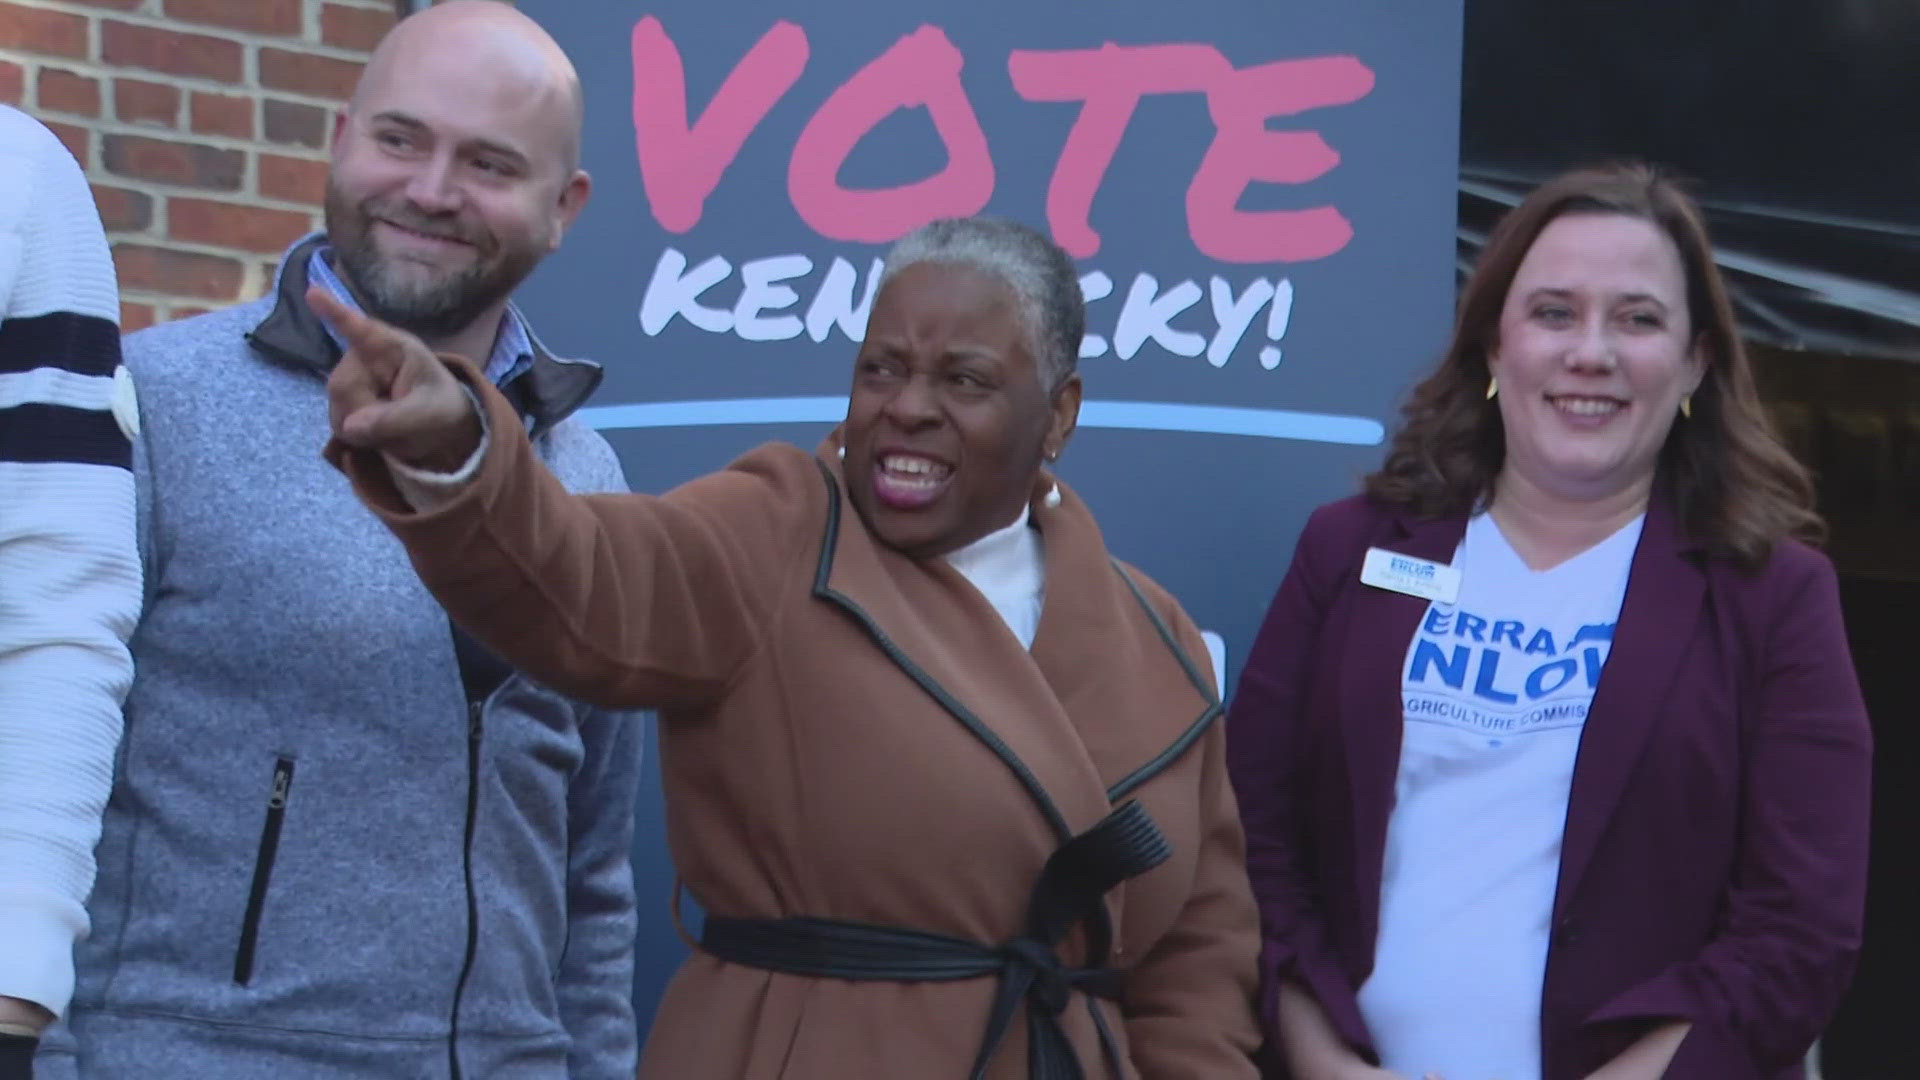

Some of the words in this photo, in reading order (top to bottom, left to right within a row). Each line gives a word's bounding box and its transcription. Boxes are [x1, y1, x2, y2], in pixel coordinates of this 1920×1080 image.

[631, 14, 1376, 264] VOTE
[640, 247, 1293, 370] KENCKY!
[1423, 606, 1557, 657] ERRA
[1407, 637, 1605, 705] NLO
[1406, 698, 1516, 731] GRICULTURE
[1521, 704, 1586, 725] COMMIS
